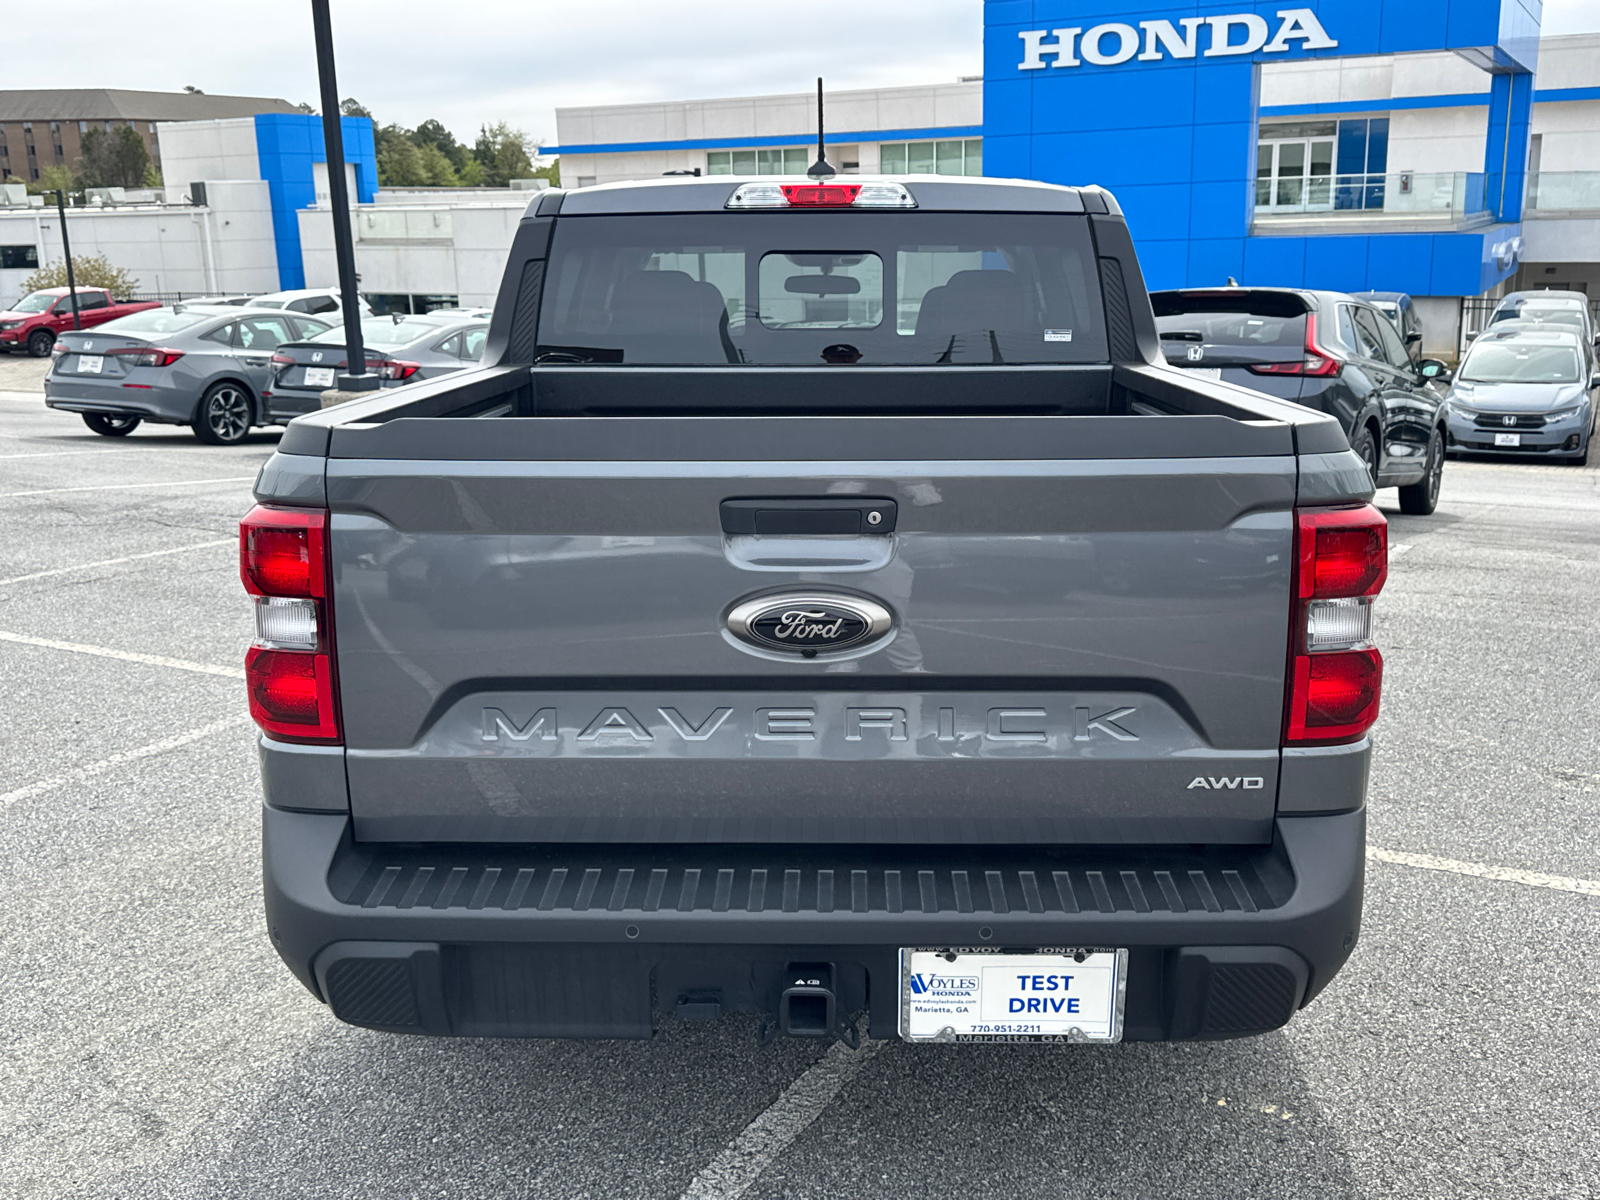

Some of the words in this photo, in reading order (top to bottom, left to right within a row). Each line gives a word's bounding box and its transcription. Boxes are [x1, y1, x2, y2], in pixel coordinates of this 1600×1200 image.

[1018, 8, 1338, 70] HONDA
[774, 610, 843, 639] Ford
[481, 706, 1140, 742] MAVERICK
[1186, 776, 1264, 790] AWD
[914, 973, 977, 993] VOYLES
[1017, 975, 1075, 991] TEST
[915, 1006, 954, 1014] Marietta,
[1008, 997, 1080, 1014] DRIVE
[970, 1025, 1041, 1033] 770-951-2211
[1041, 1034, 1066, 1042] GA
